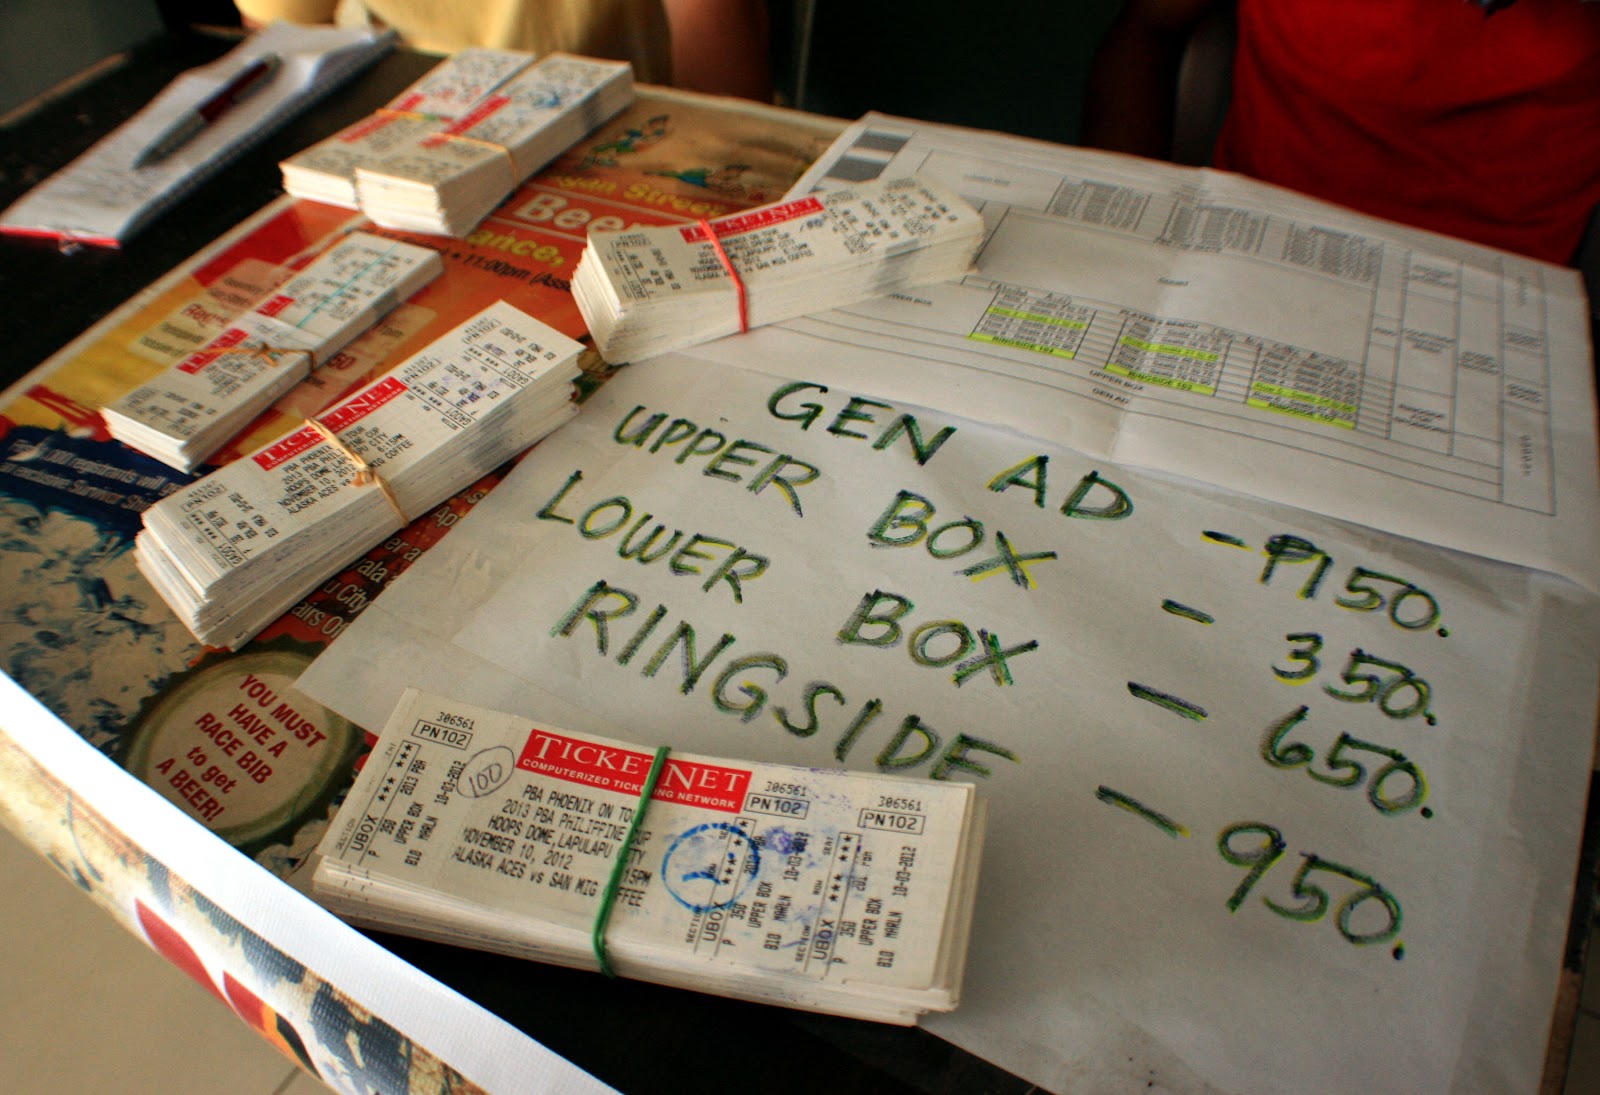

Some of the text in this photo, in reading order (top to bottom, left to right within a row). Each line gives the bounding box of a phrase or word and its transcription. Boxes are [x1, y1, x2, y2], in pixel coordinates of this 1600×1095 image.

[466, 230, 565, 267] ance,
[767, 381, 957, 466] GEN
[986, 454, 1135, 522] AD
[613, 404, 822, 518] UPPER
[866, 488, 1058, 590] BOX
[535, 469, 771, 605] LOWER
[836, 588, 1040, 688] BOX
[291, 600, 327, 627] airs
[550, 579, 1021, 781] RINGSIDE
[227, 703, 289, 759] HAVE A
[239, 672, 328, 749] YOU MUST
[436, 711, 475, 731] 306561
[194, 712, 274, 785] RACE BIB
[419, 724, 468, 746] PN102
[186, 746, 238, 795] to get
[410, 758, 428, 775] PBA
[522, 758, 610, 786] COMPUTERIZED
[677, 791, 736, 809] NETWORK
[155, 757, 226, 822] A BEER!
[522, 784, 545, 803] PBA
[547, 790, 594, 815] PHOENIX
[597, 803, 614, 819] ON
[750, 796, 802, 815] PN102
[765, 781, 808, 797] 306561
[878, 796, 922, 812] 306561
[350, 814, 379, 851] UBOX
[394, 801, 425, 845] UPPER BOX
[487, 815, 524, 837] HOOPS
[501, 798, 531, 819] 2013
[535, 806, 554, 825] PBA
[558, 812, 628, 842] PHILIPPINE
[864, 812, 918, 831] PN102
[463, 827, 516, 856] NOVEMBER
[519, 843, 536, 864] 10,
[543, 850, 575, 871] 2012
[812, 879, 823, 896] ROW
[822, 837, 834, 856] SEAT
[892, 845, 917, 897] 10-03-2012
[452, 846, 495, 869] ALASKA
[496, 860, 527, 879] ACES
[548, 871, 573, 891] SAN
[575, 879, 599, 898] MIG
[702, 901, 726, 942] UBOX
[748, 880, 774, 929] UPPER BOX
[858, 897, 883, 946] UPPER BOX
[884, 911, 903, 939] MARLN
[812, 919, 835, 961] UBOX
[839, 920, 857, 938] 350
